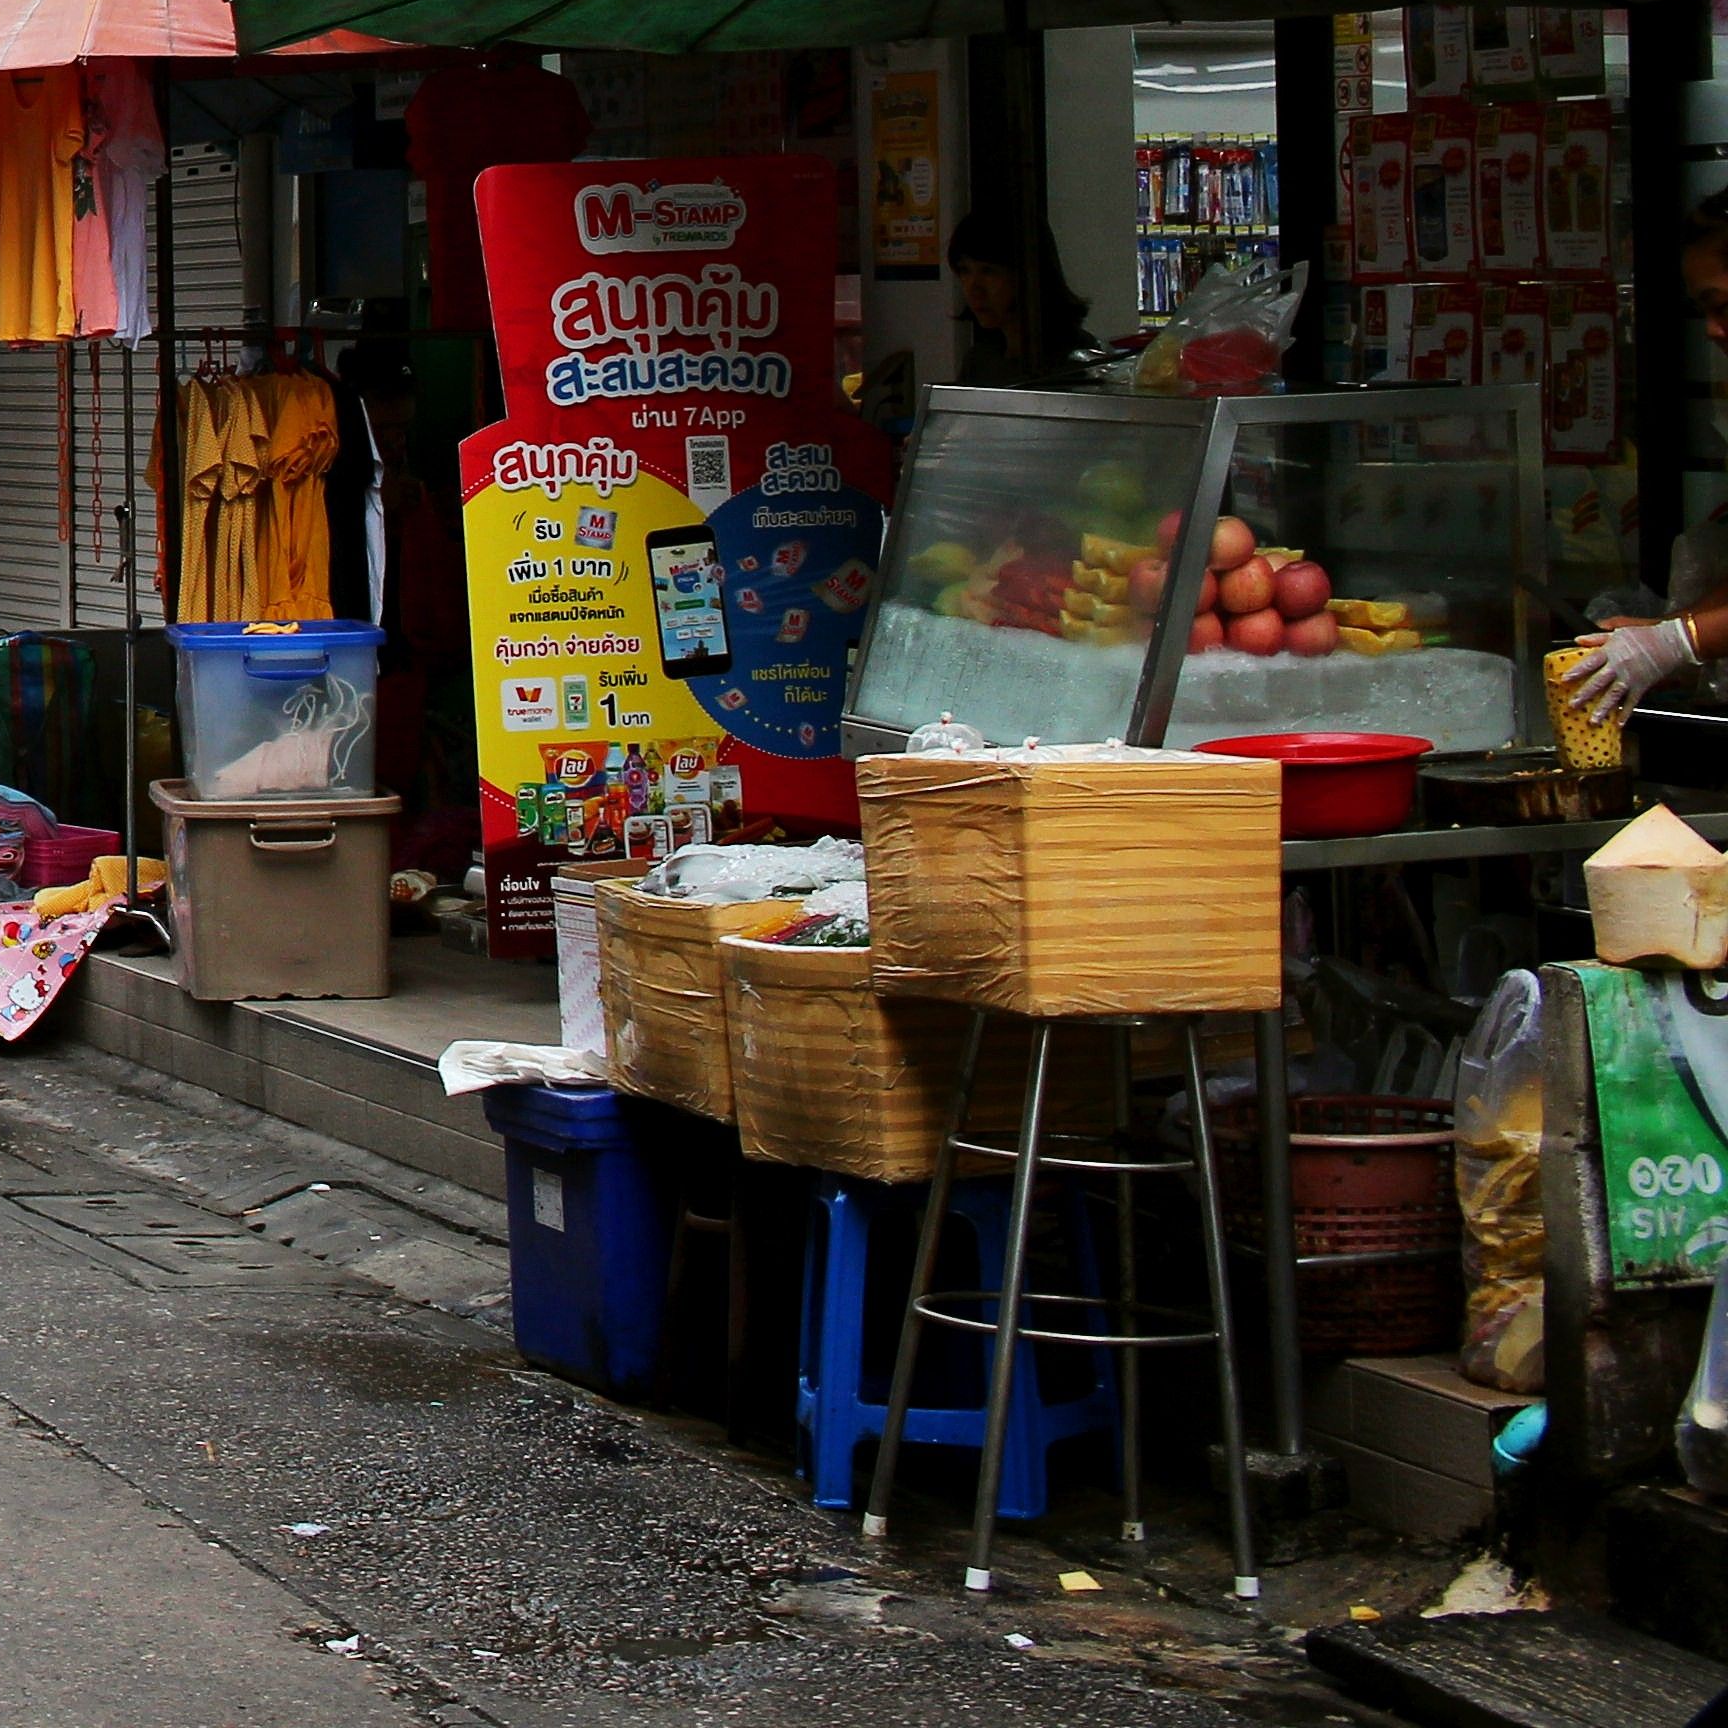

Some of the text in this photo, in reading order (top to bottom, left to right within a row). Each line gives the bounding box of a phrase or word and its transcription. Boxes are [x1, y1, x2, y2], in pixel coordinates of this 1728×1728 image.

[585, 192, 739, 238] M-STAMP
[557, 268, 776, 352] สนุกคุ้ม
[552, 354, 788, 401] สะสมสะดวก
[632, 403, 677, 428] ผ่าน
[498, 442, 632, 493] สนุกคุ้ม
[768, 444, 830, 470] สะสม
[763, 469, 839, 493] สะดวก
[535, 519, 561, 539] รับ
[753, 506, 856, 528] เก็บสะสมง่ายๆ
[508, 552, 611, 582] เพิ่ม 1 บาท
[528, 585, 604, 604] เมื่อซื้อสินค้า
[509, 605, 625, 623] แจกแสตมป์จัดหนัก
[495, 633, 640, 664] คุ้มกว่า จ่ายด้วย
[598, 664, 648, 688] รับเพิ่ม
[751, 658, 832, 681] แชร์ให้เพื่อน
[784, 684, 828, 704] ก็ได้นะ
[600, 693, 650, 726] 1 บาท
[500, 874, 540, 892] เงื่อนไข
